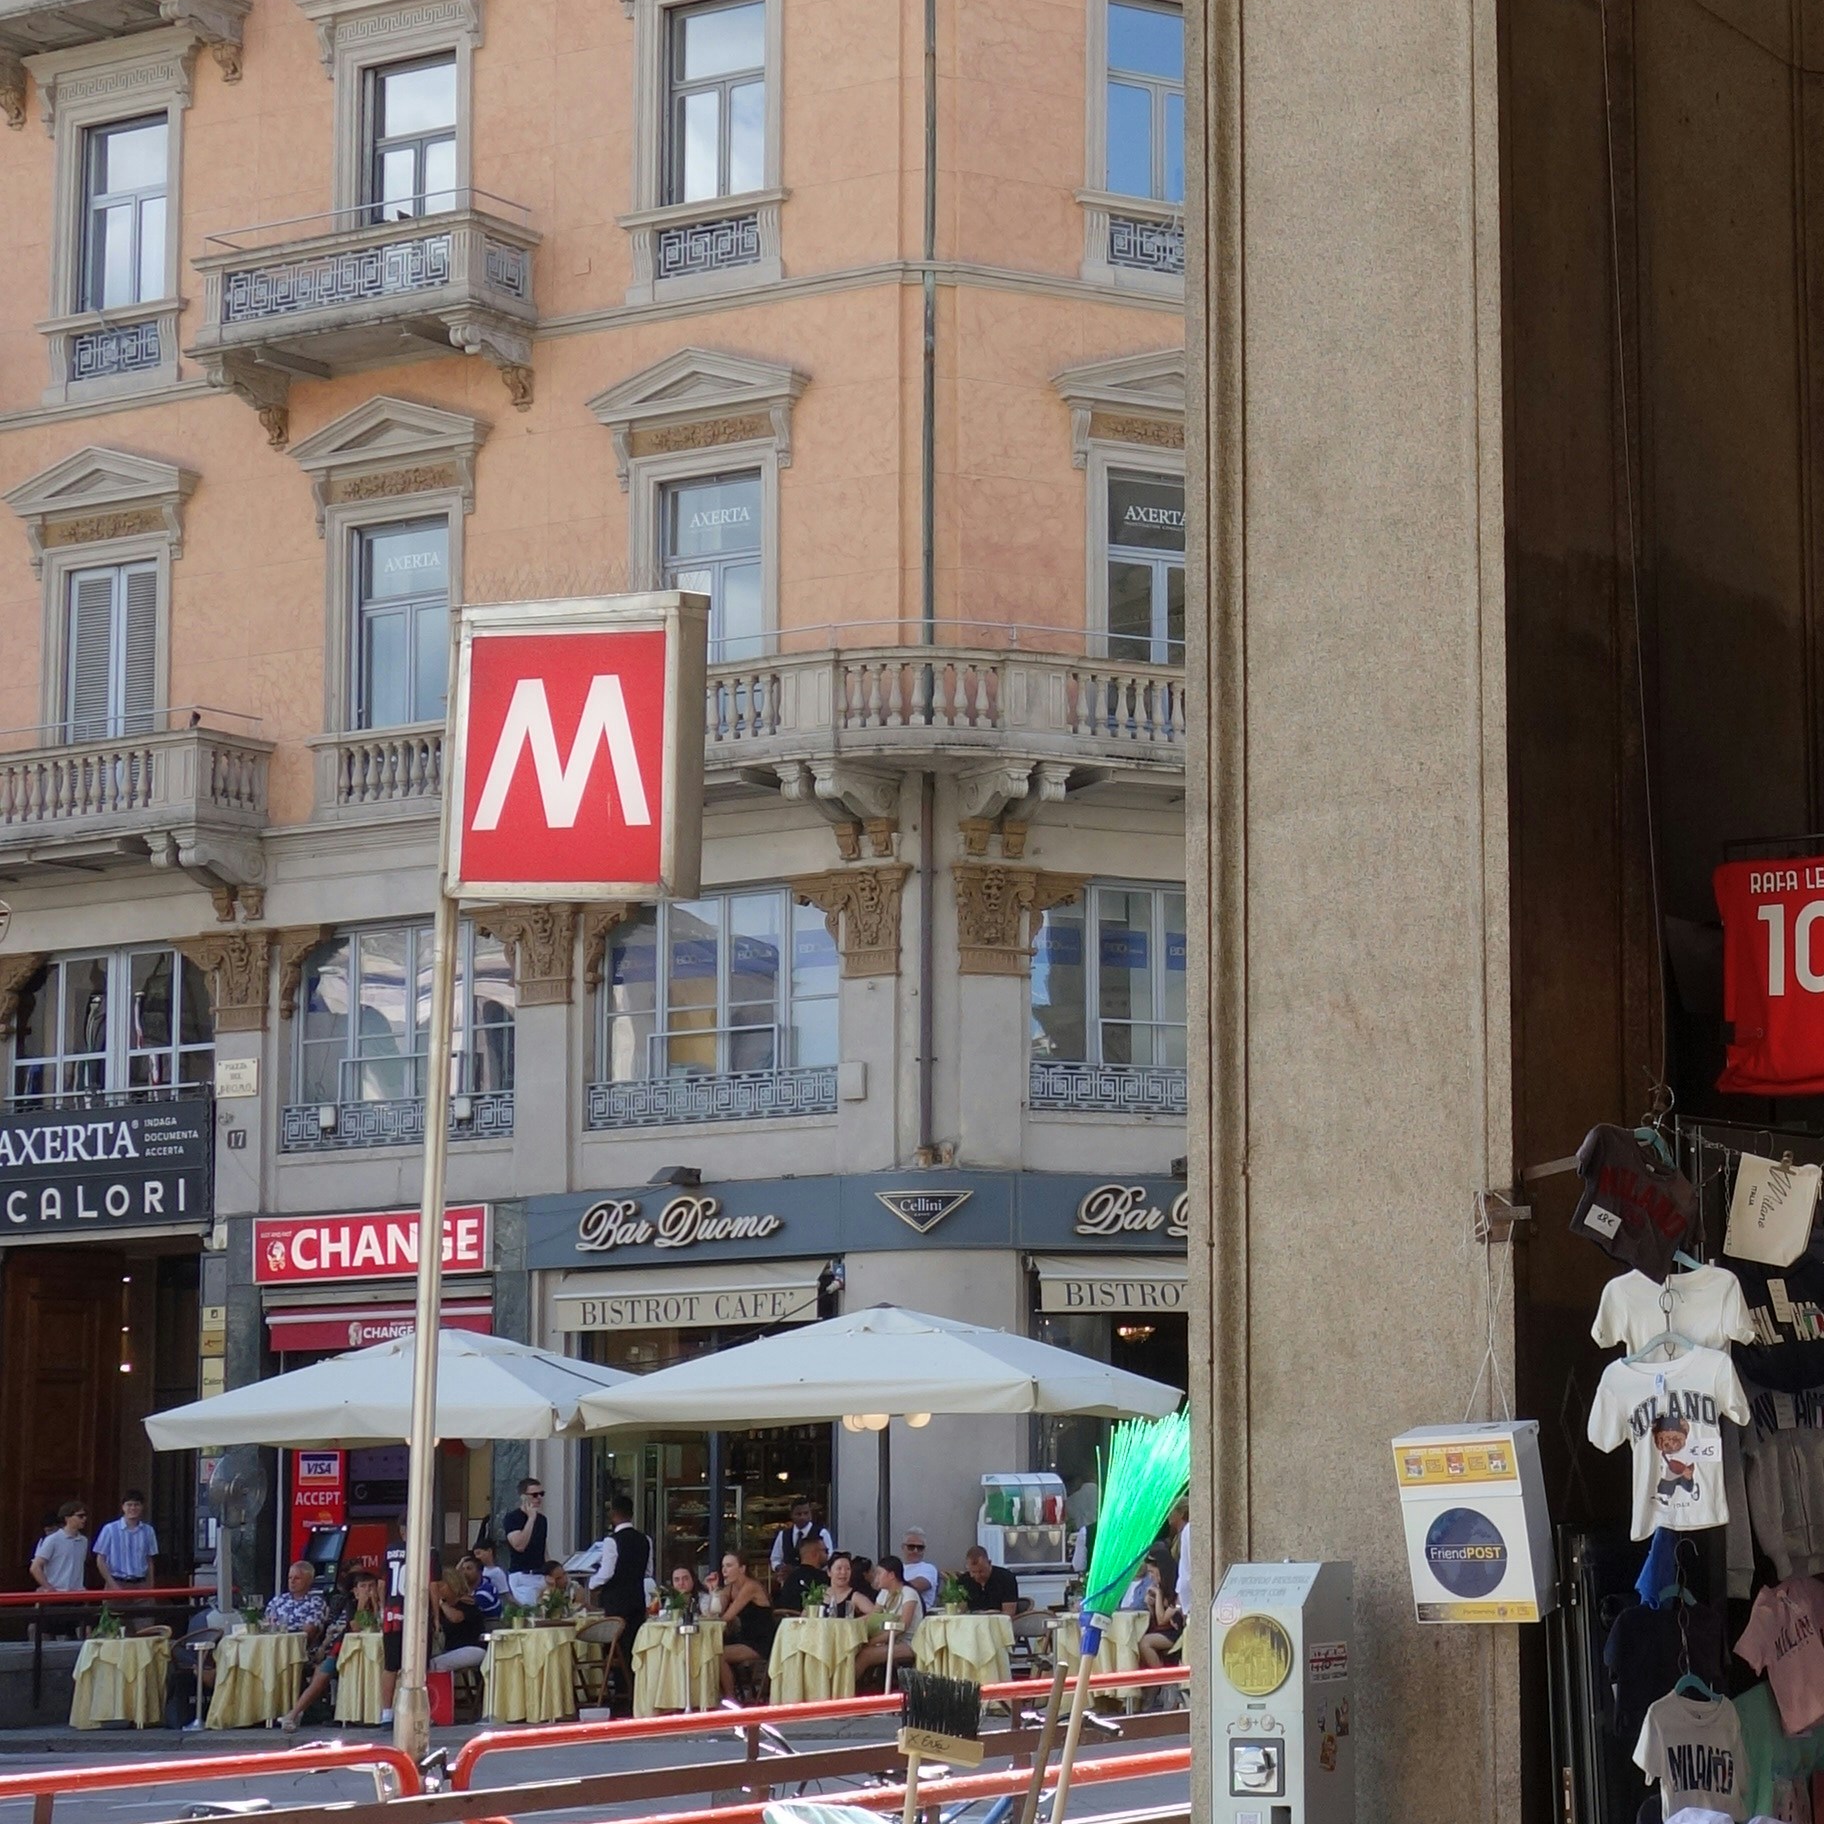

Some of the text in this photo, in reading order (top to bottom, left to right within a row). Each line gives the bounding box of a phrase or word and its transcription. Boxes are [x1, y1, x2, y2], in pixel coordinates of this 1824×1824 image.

[690, 507, 751, 529] AXERTA
[384, 552, 441, 572] AXERTA
[471, 674, 651, 831] M
[1750, 870, 1798, 894] RAFA
[144, 1117, 177, 1127] INDAGA
[144, 1131, 199, 1142] DOCUMENTA
[230, 1132, 244, 1147] 17
[145, 1146, 185, 1157] ACCERTA
[6, 1178, 186, 1223] CALORI
[899, 1196, 943, 1212] Cellini
[1075, 1184, 1165, 1236] Bar
[575, 1196, 783, 1252] Bar Duomo
[580, 1297, 700, 1326] BISTROT
[363, 1325, 415, 1340] CHANGE
[1627, 1389, 1719, 1443] MILANO
[1689, 1446, 1698, 1456] €
[306, 1462, 333, 1475] VISA
[295, 1491, 341, 1506] ACCEPT
[1430, 1546, 1503, 1560] FriendPOST
